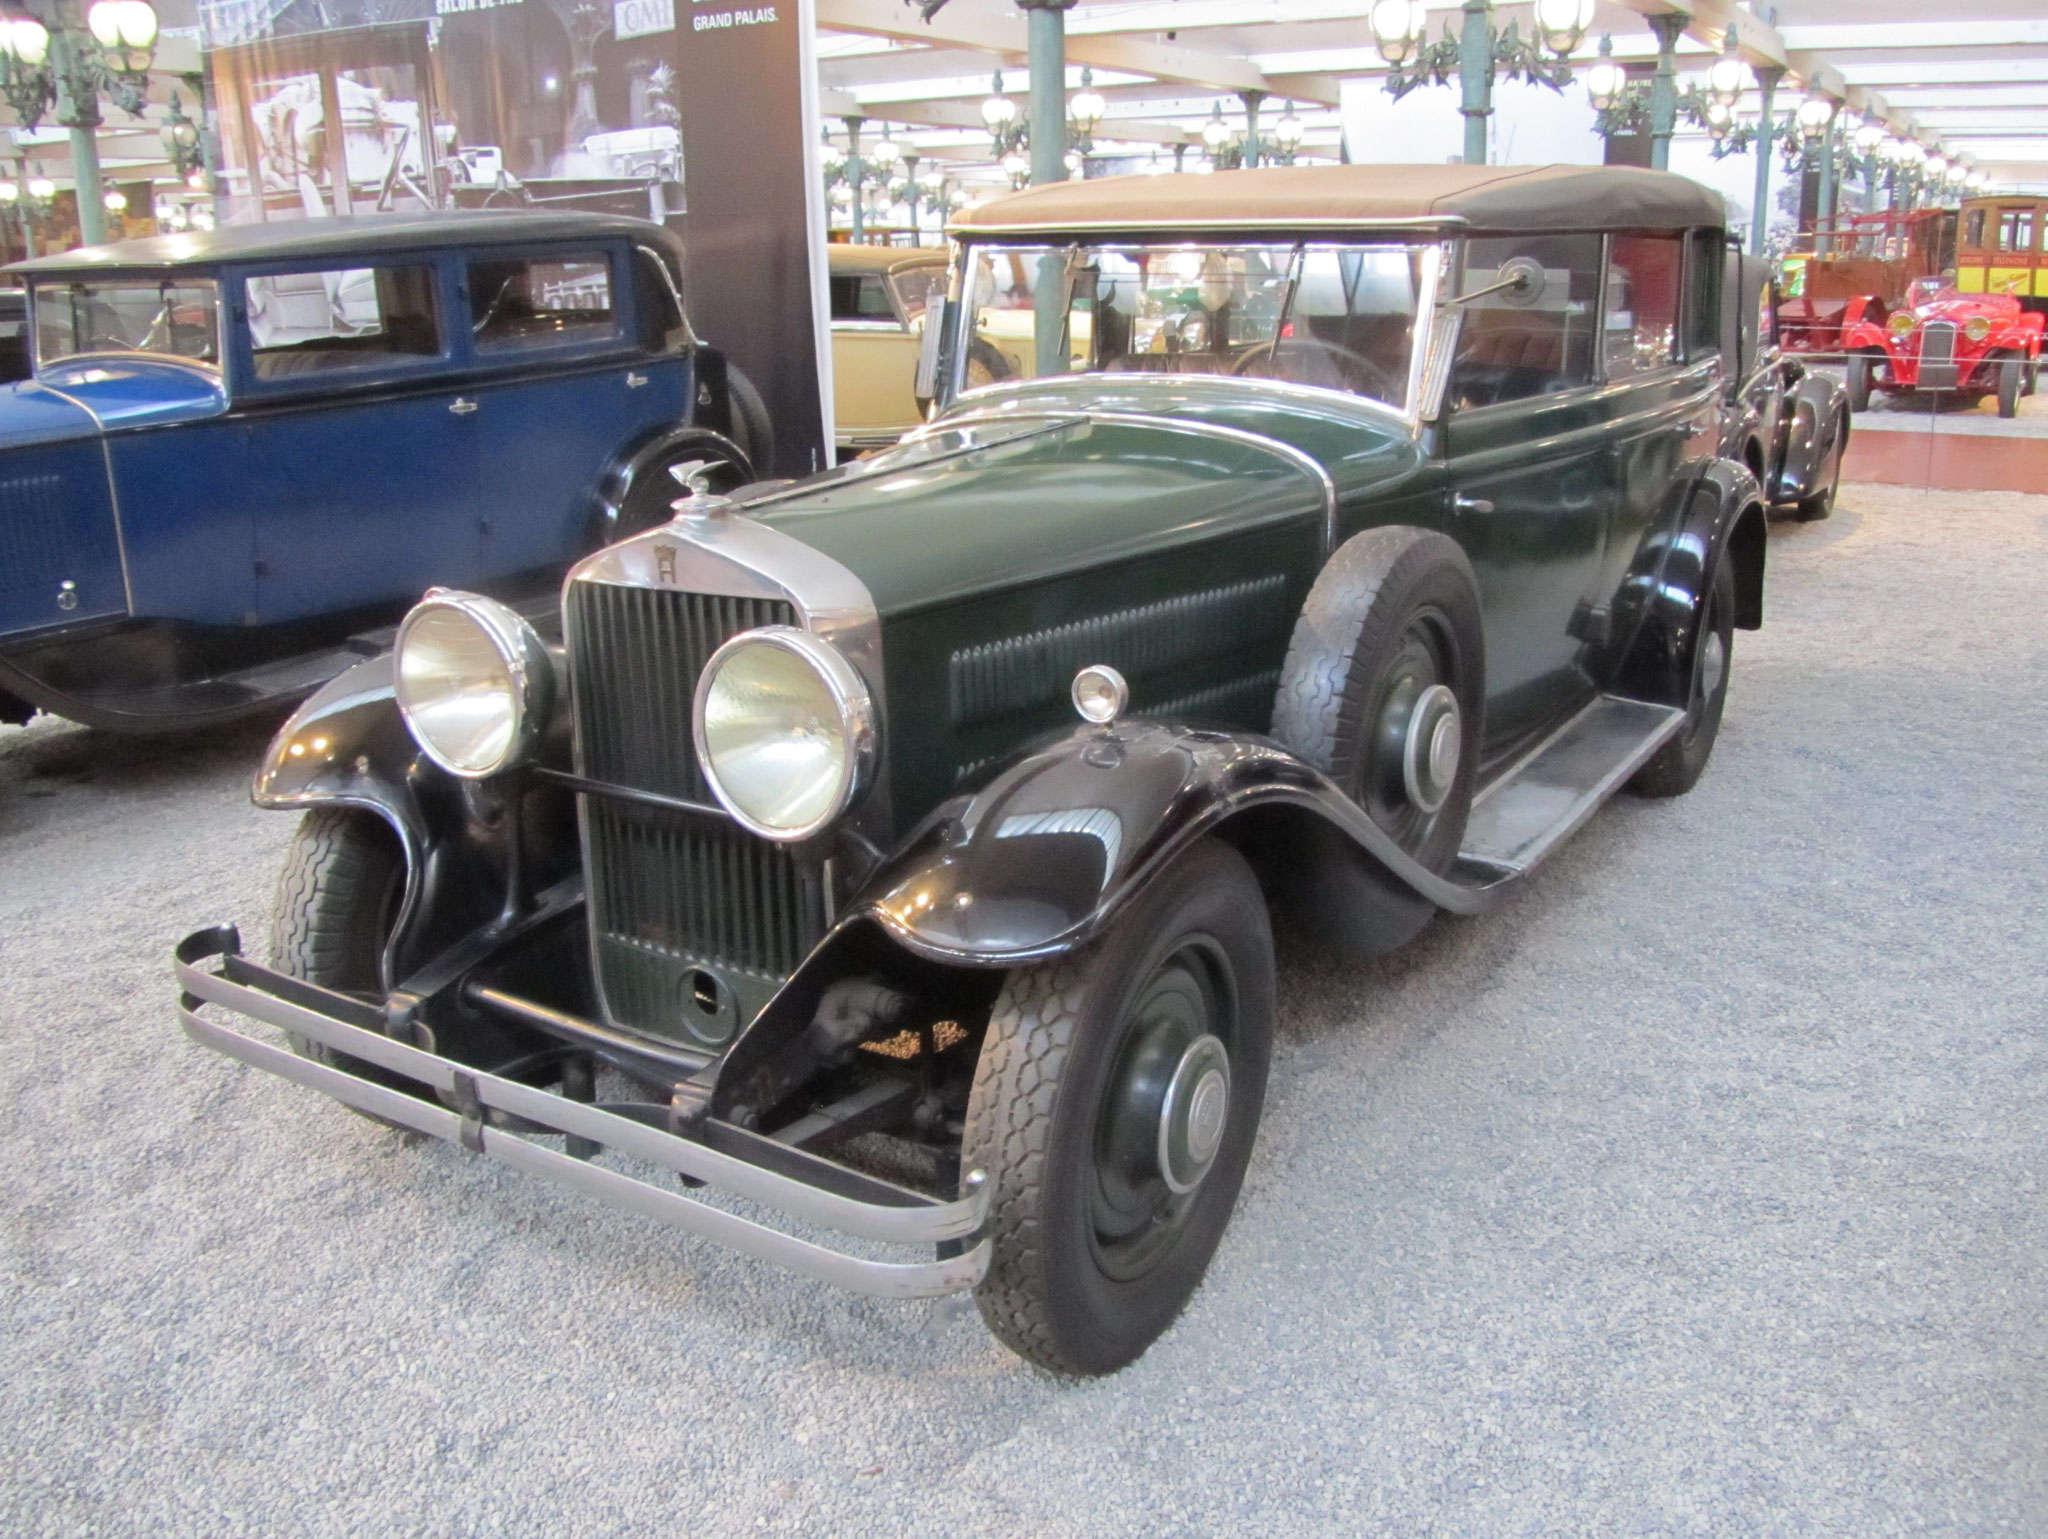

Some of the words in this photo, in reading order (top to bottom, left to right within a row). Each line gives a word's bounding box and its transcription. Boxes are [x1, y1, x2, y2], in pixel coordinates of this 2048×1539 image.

[436, 0, 475, 14] SALON
[693, 13, 731, 31] GRAND
[735, 7, 778, 25] PALAIS.
